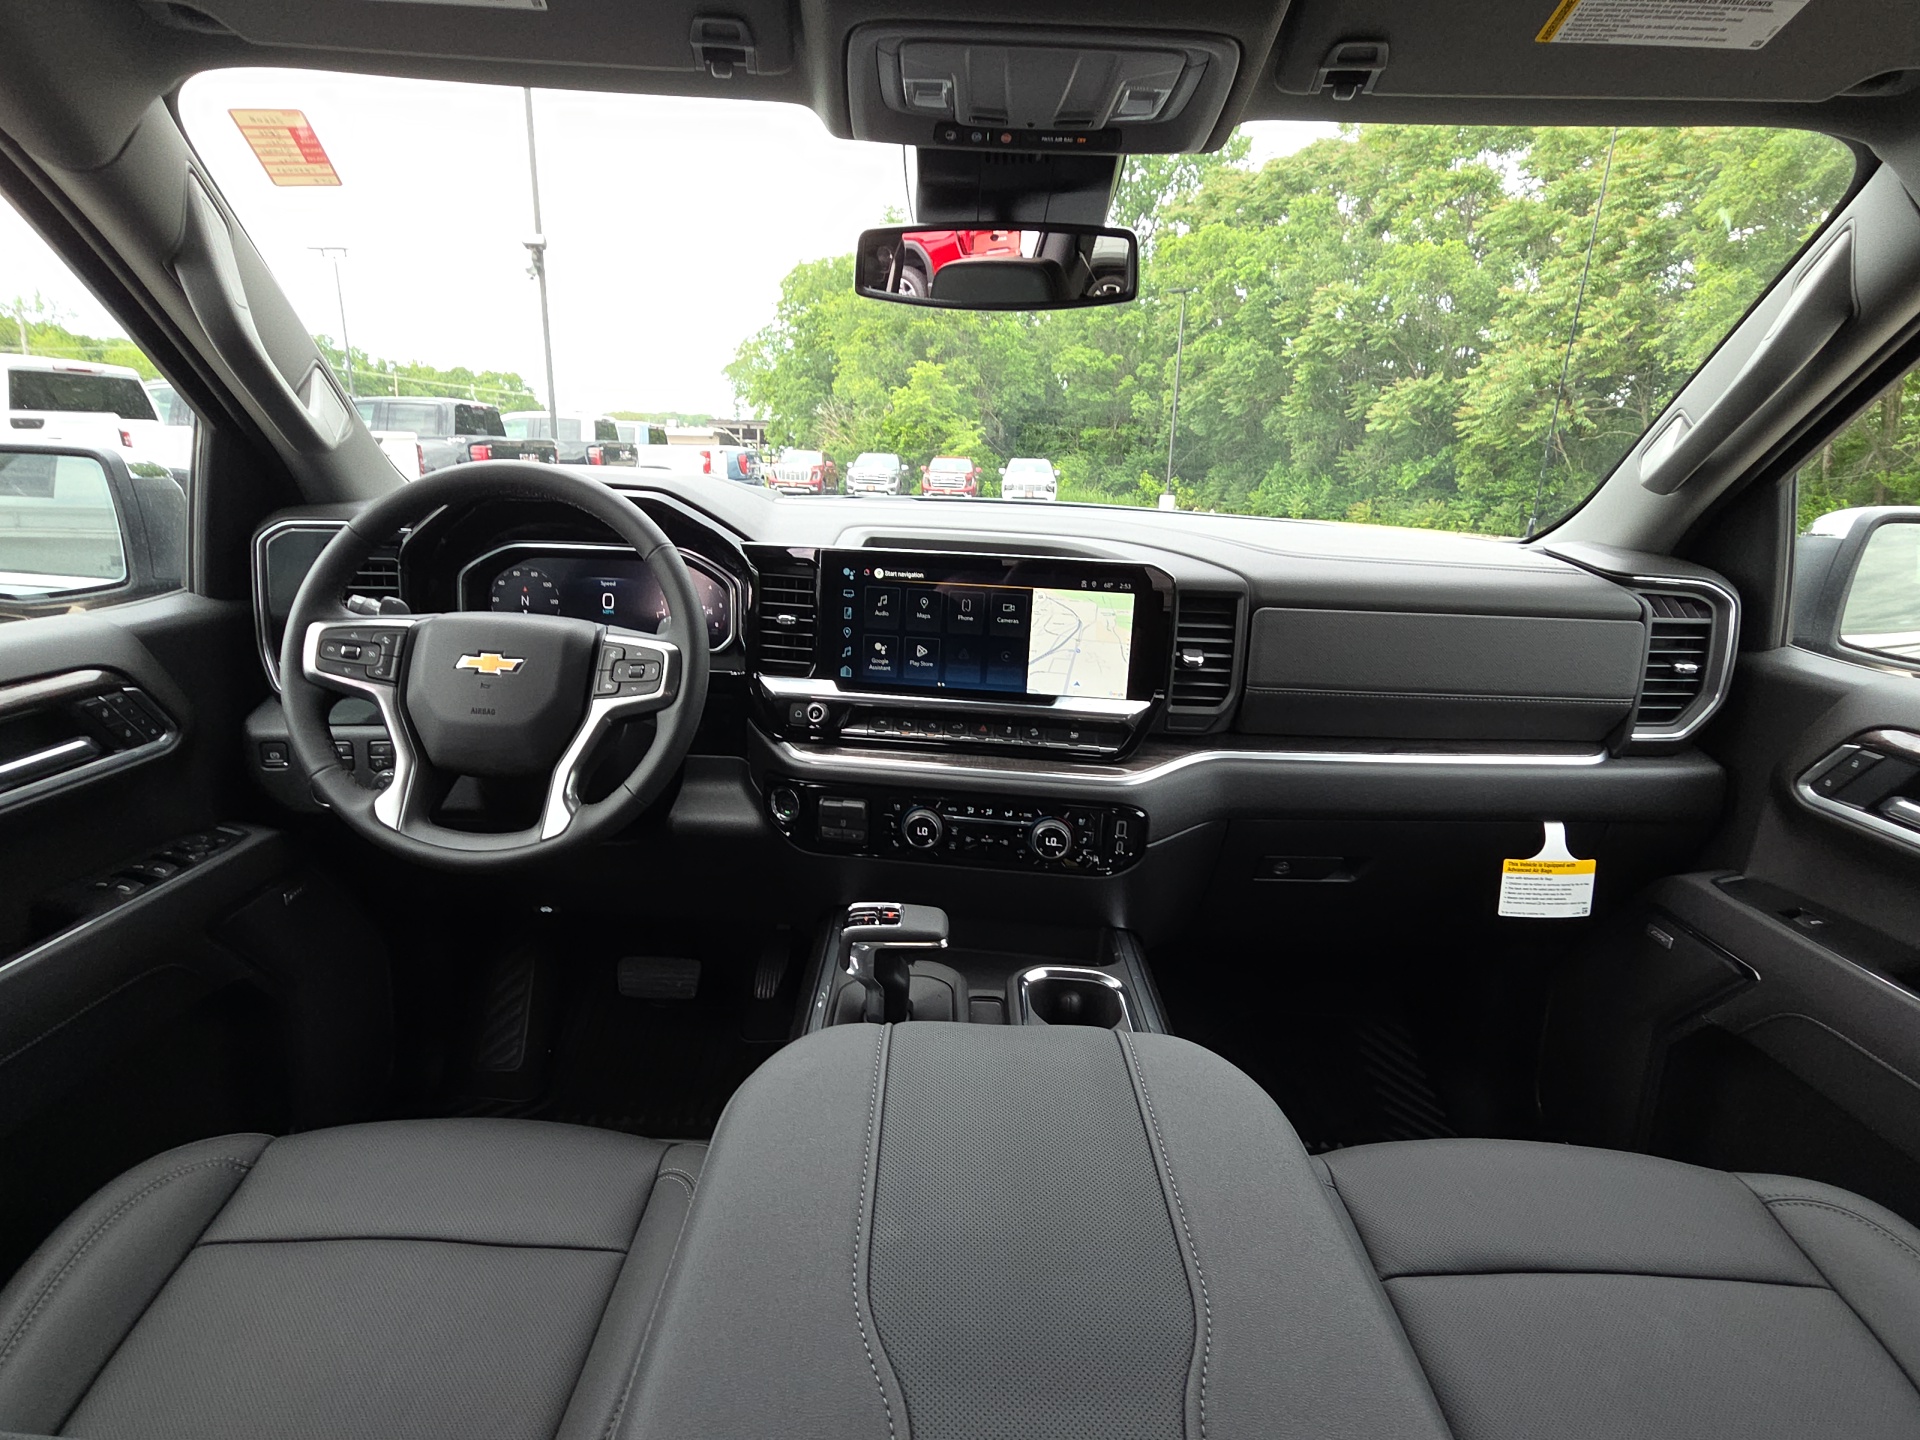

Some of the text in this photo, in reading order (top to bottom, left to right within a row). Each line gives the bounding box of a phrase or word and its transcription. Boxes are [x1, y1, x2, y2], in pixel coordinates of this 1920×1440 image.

[898, 571, 924, 579] navigation
[874, 609, 889, 617] Audio
[916, 611, 931, 619] Maps
[957, 614, 974, 622] Phone
[996, 617, 1020, 625] Cameras
[871, 657, 889, 665] Google
[470, 707, 496, 716] AIRBAG
